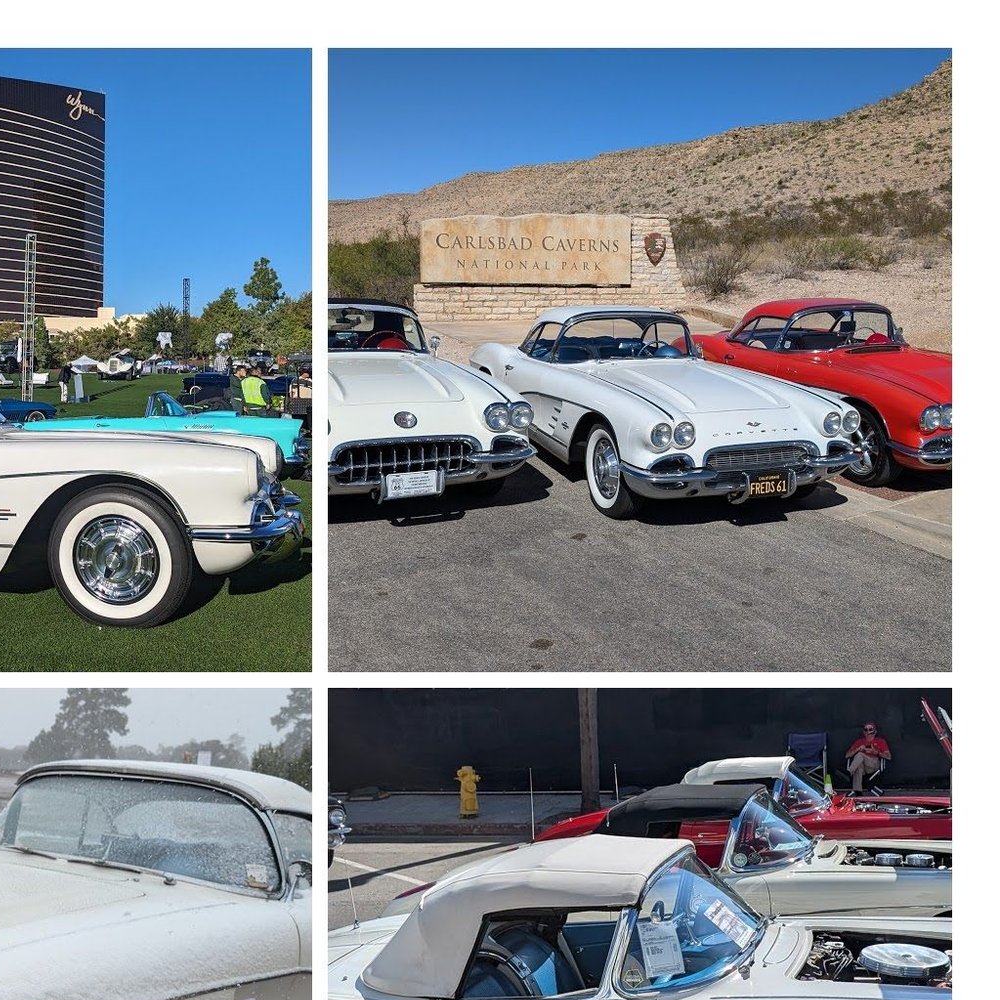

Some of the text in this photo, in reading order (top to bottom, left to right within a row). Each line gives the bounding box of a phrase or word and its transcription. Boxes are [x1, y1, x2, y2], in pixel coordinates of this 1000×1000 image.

[457, 259, 602, 271] NATIONAL PARK
[750, 480, 787, 495] FREDS 61
